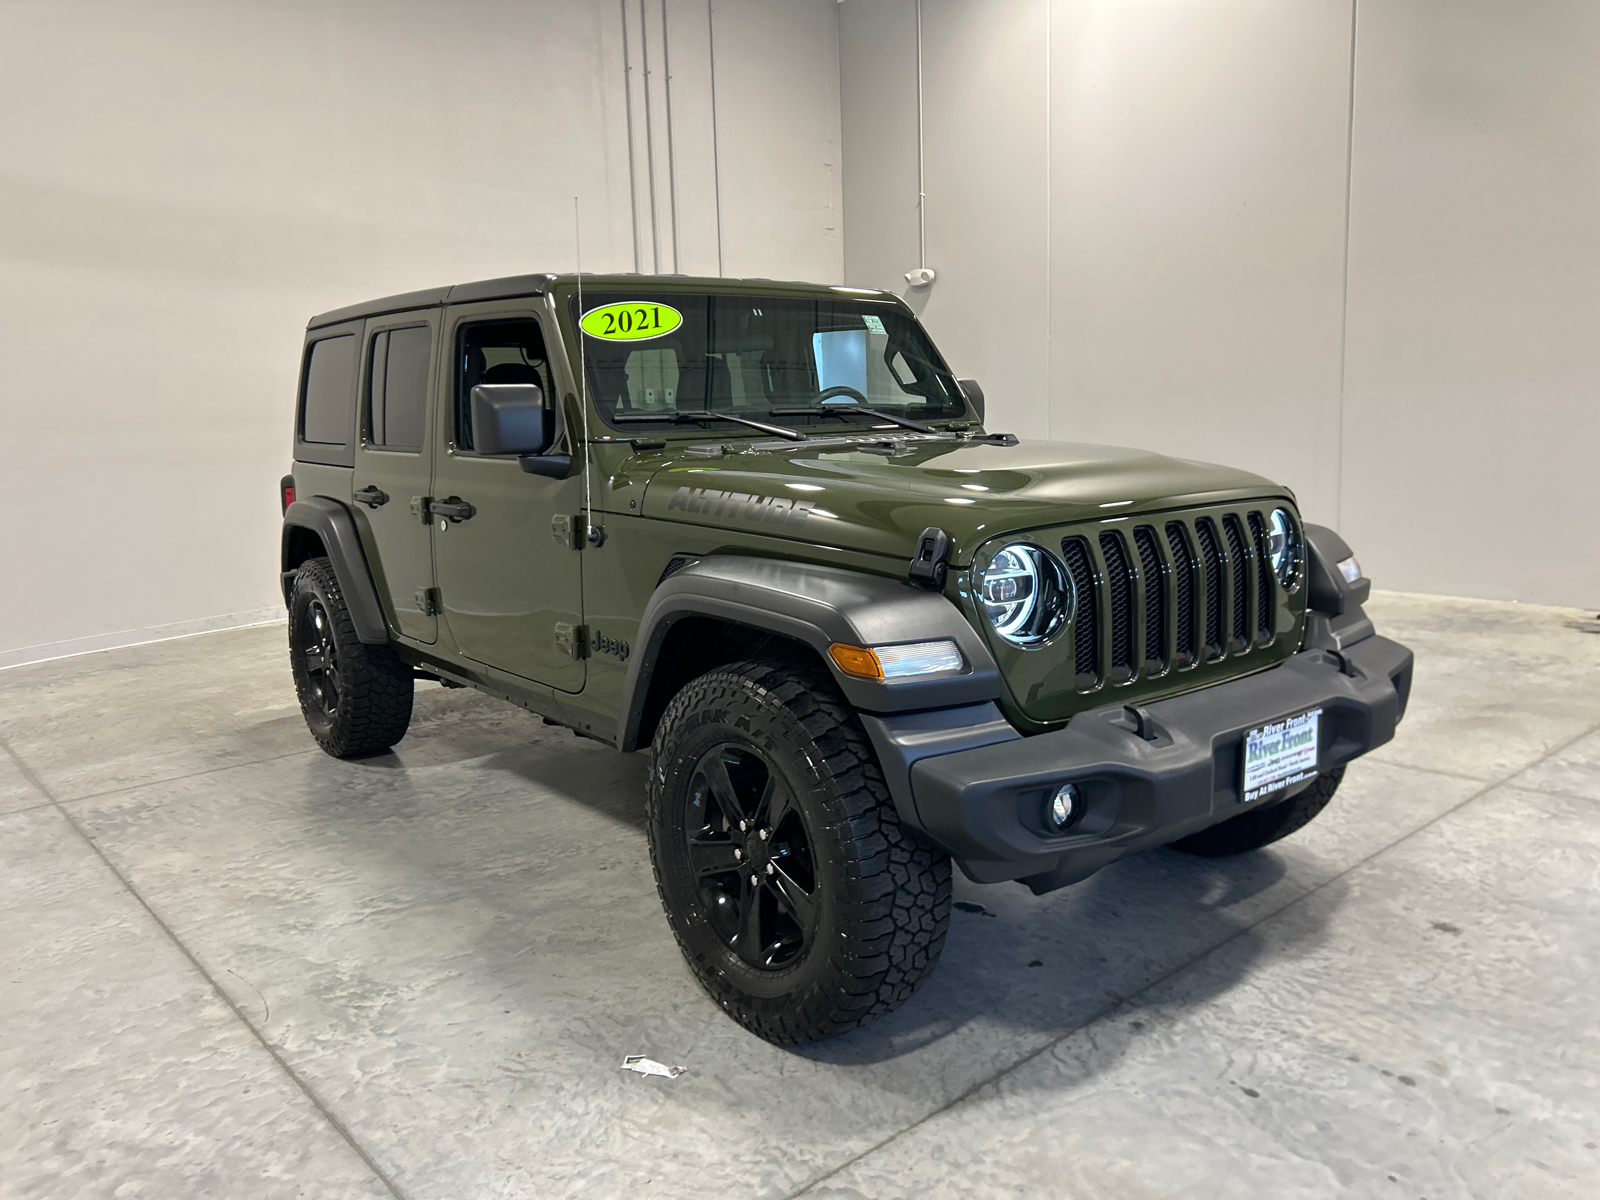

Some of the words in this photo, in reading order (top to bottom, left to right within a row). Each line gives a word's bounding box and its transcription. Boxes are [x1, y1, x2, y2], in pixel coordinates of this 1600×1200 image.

[601, 306, 663, 335] 2021
[667, 486, 816, 526] ALTITUDE
[591, 630, 629, 661] Jeep
[1263, 722, 1285, 738] River
[1286, 714, 1306, 729] Front
[1244, 790, 1259, 802] Buy
[1259, 786, 1267, 797] At
[1267, 780, 1285, 792] River
